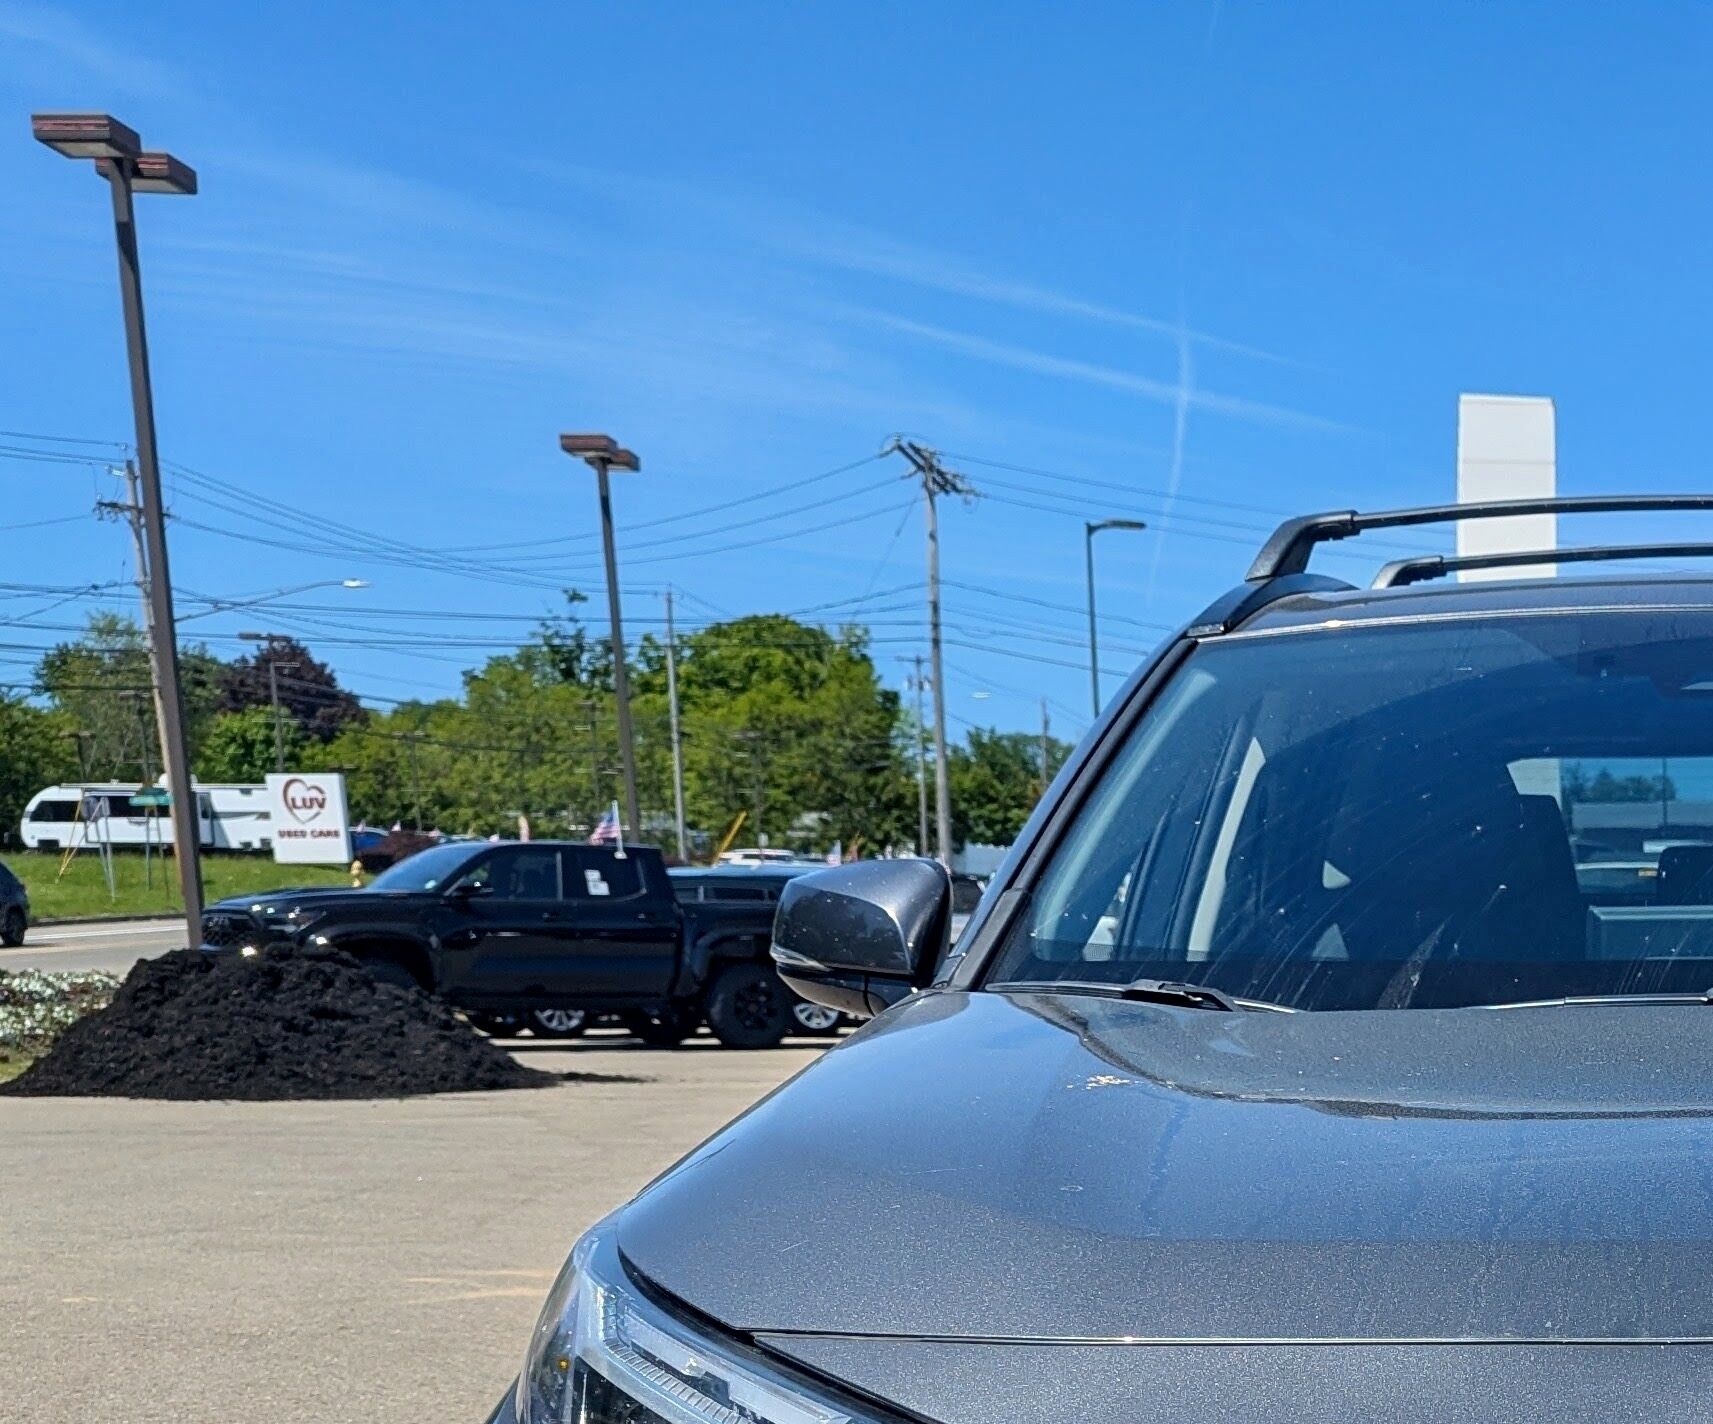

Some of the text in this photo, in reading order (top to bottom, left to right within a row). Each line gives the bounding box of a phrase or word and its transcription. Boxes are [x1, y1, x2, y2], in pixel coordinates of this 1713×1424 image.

[291, 797, 326, 809] LUV
[278, 829, 340, 839] USED CARS
